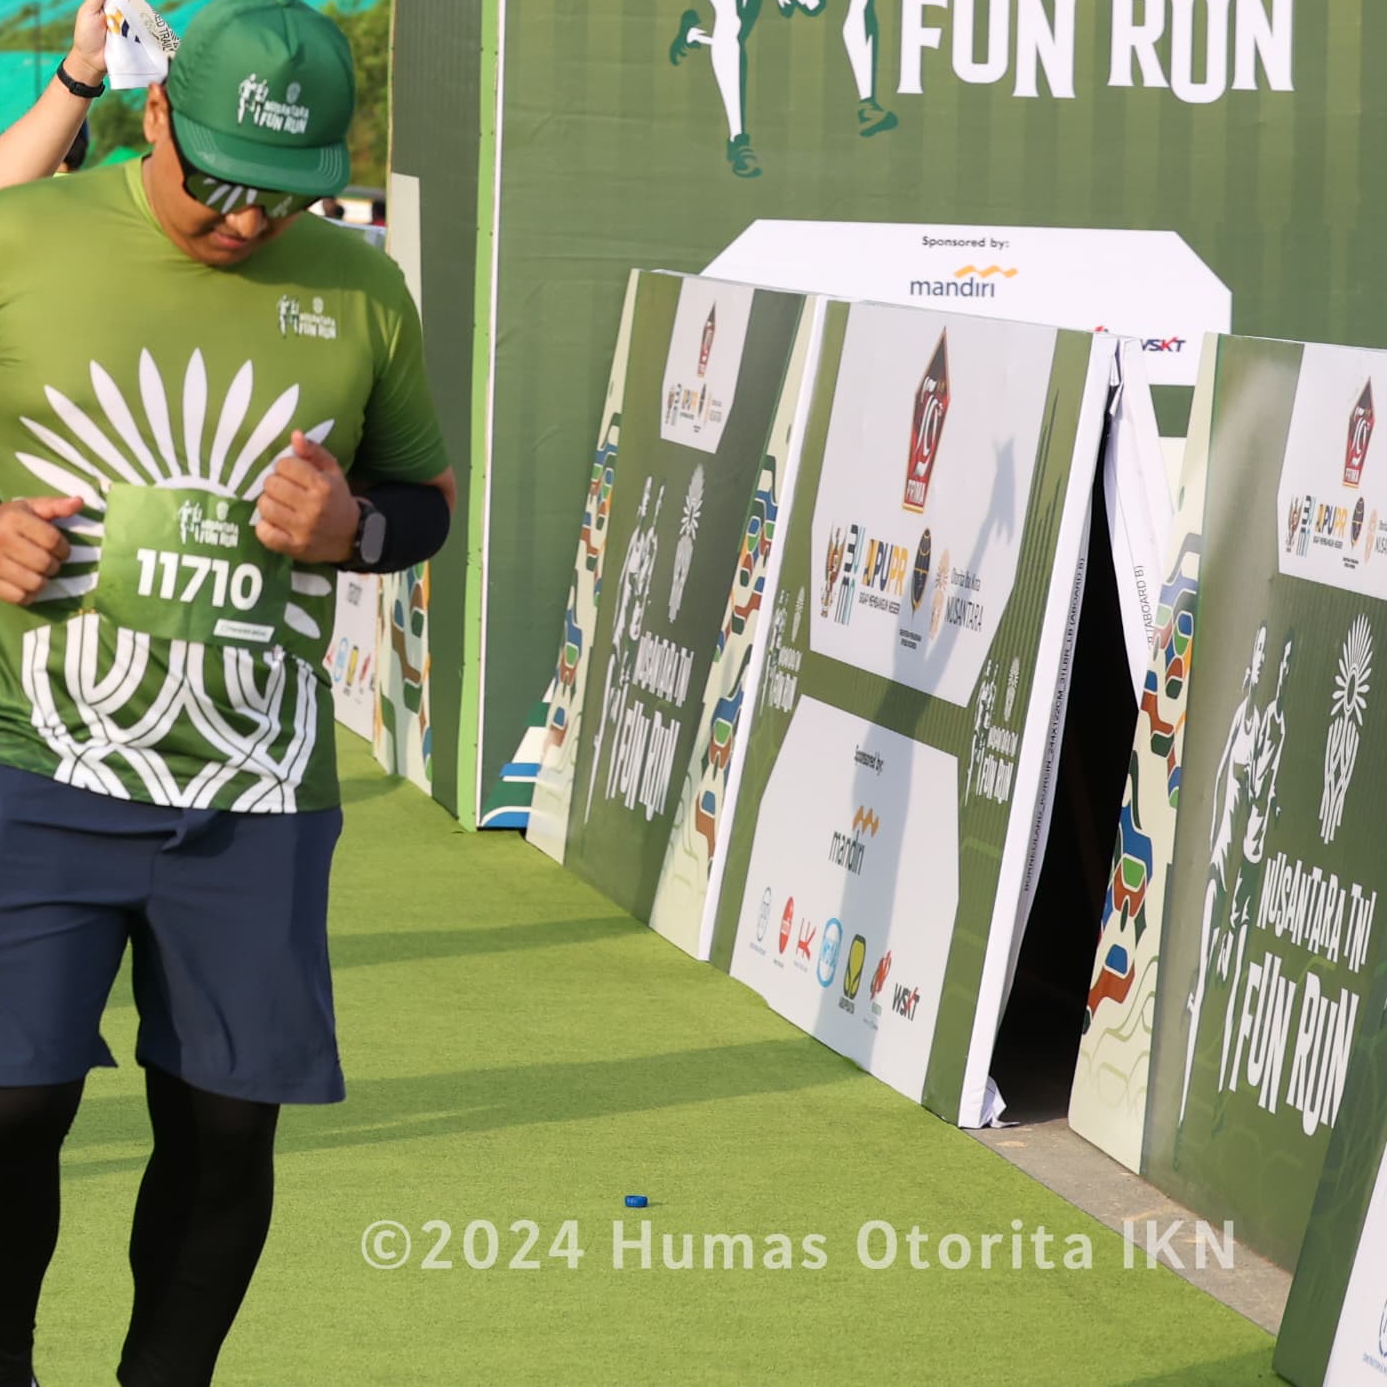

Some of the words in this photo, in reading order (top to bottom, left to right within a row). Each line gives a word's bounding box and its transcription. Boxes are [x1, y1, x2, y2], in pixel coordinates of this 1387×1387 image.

[259, 113, 283, 131] FUN
[283, 116, 309, 135] RUN
[922, 236, 986, 248] Sponsored
[990, 237, 1010, 250] by:
[909, 277, 996, 298] mandiri
[136, 547, 264, 611] 11710
[870, 540, 909, 597] PUPR
[632, 631, 679, 703] NUSANTARA
[674, 647, 695, 708] TNI
[610, 700, 651, 811] FUN
[638, 710, 681, 822] RUN
[1256, 852, 1347, 964] NUSANTARA
[1344, 882, 1378, 974] TNI
[891, 982, 920, 1022] WSKT
[1228, 951, 1297, 1115] FUN
[1285, 971, 1361, 1137] RUN
